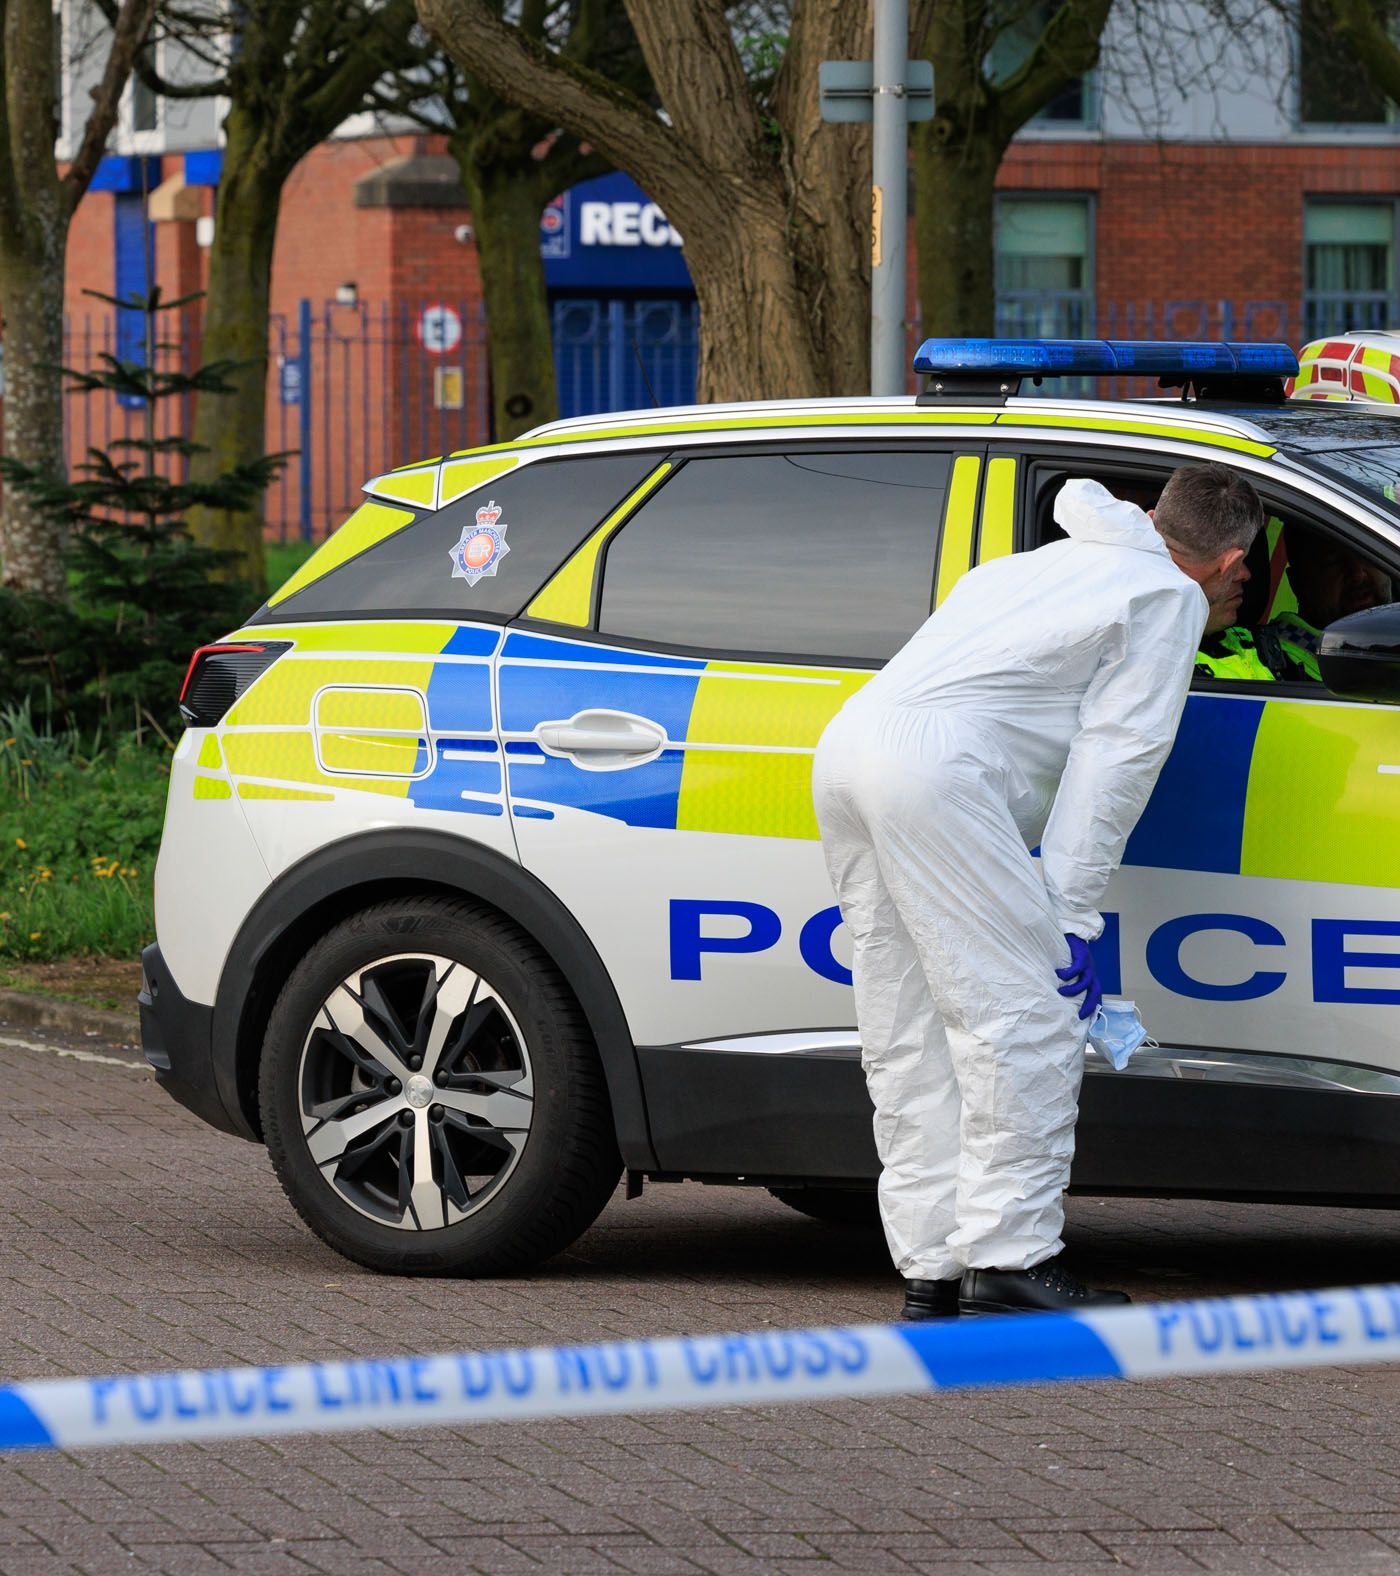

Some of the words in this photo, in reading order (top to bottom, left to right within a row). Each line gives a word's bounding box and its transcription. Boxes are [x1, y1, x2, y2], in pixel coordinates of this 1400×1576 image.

[1151, 1291, 1341, 1358] POLICE
[89, 1366, 291, 1425] POLICE
[313, 1356, 439, 1409] LINE
[457, 1349, 537, 1400] DO
[553, 1341, 660, 1393] NOT
[681, 1326, 871, 1386] CROSS
